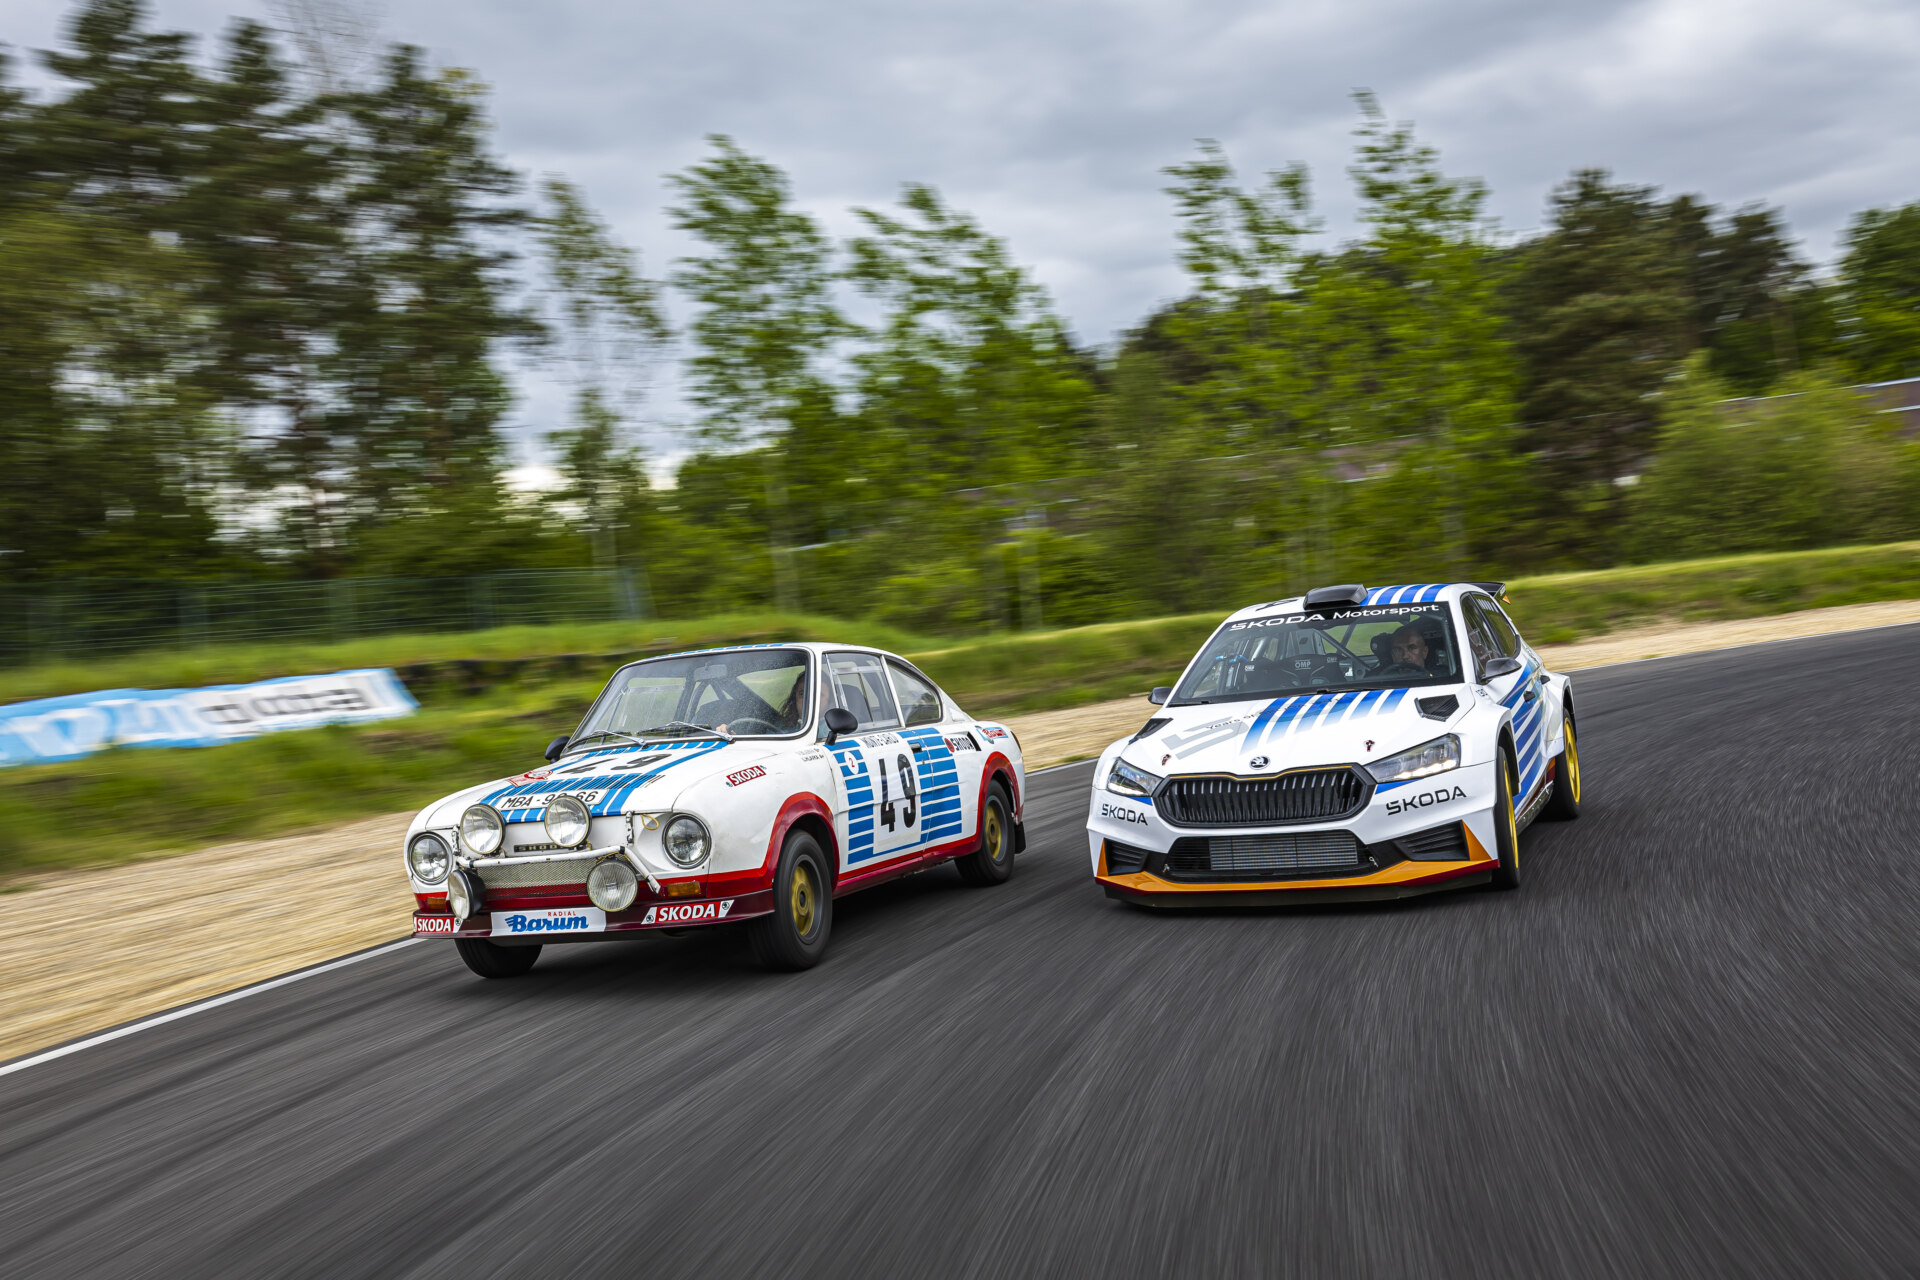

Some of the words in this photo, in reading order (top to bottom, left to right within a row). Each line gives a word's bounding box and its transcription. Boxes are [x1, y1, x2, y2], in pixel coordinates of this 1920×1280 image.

[1333, 604, 1439, 620] Motorsport
[1294, 661, 1311, 669] OMP
[848, 757, 856, 768] 2
[729, 766, 765, 786] SKODA
[879, 753, 917, 833] 49
[658, 903, 716, 922] SKODA
[417, 918, 451, 932] SKODA
[506, 914, 589, 933] Barum
